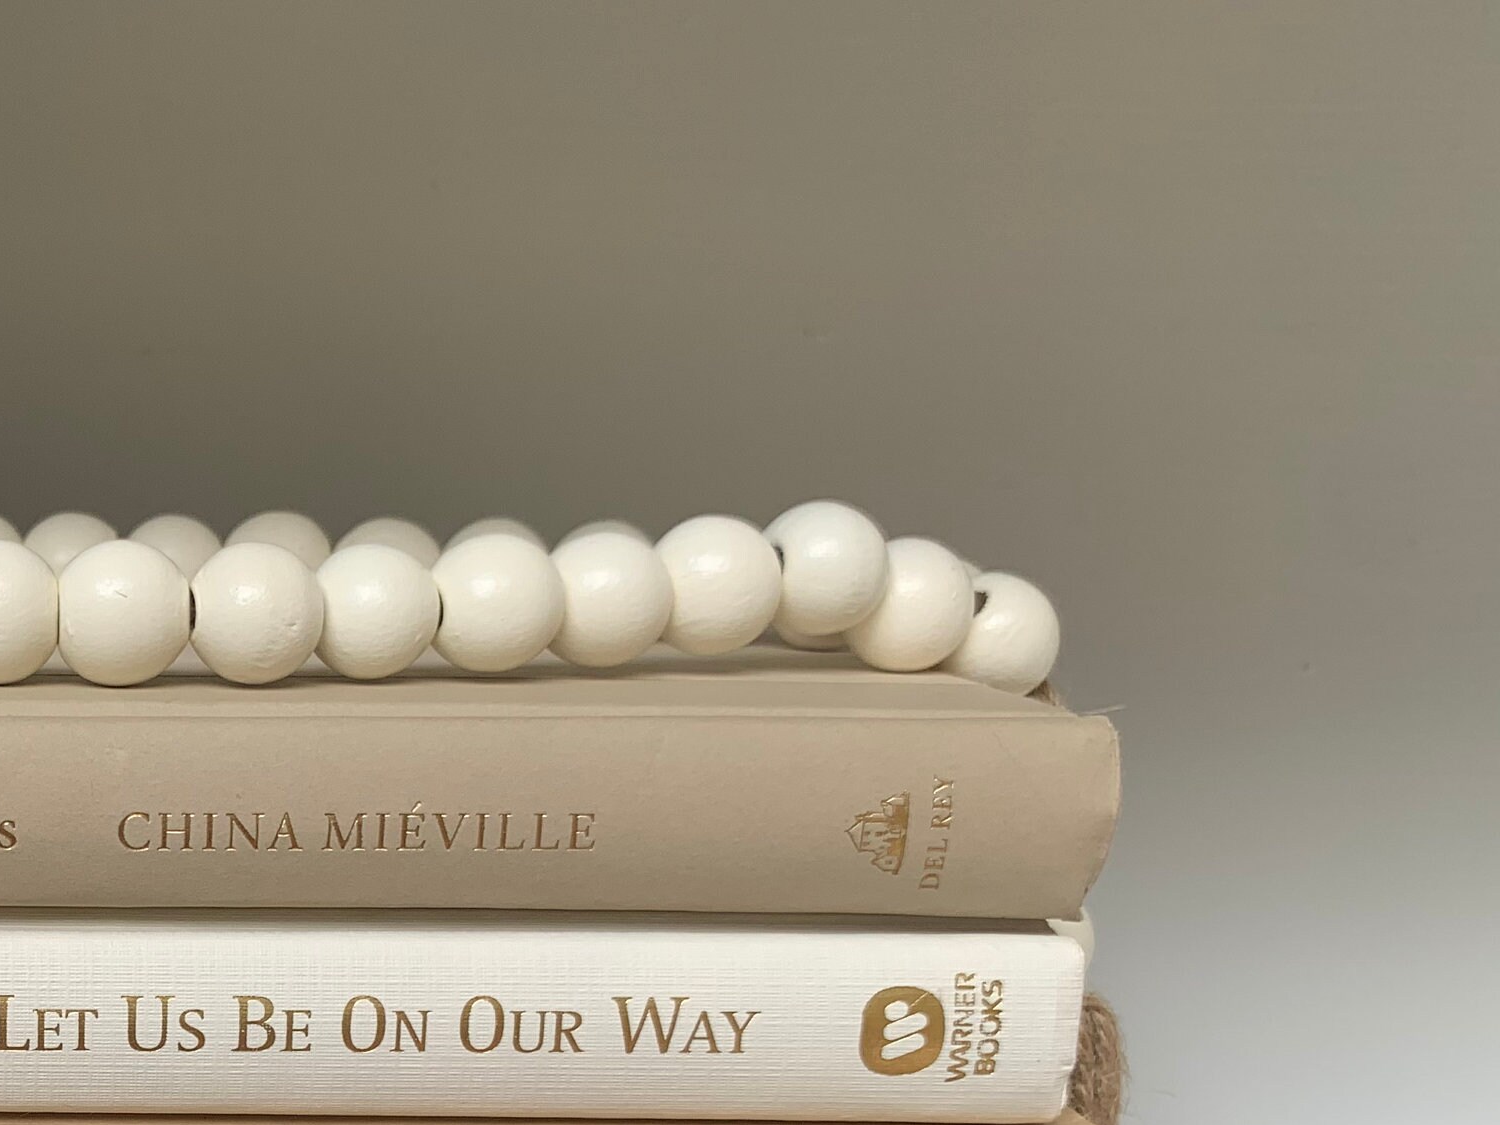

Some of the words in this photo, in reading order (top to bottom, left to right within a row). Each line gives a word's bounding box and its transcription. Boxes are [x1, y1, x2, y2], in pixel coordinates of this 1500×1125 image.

[117, 811, 303, 853] CHINA
[321, 801, 598, 853] MIÉVILLE
[930, 775, 955, 830] REY
[918, 838, 948, 890] DEL
[120, 995, 207, 1053] US
[231, 995, 313, 1053] BE
[341, 995, 433, 1054] ON
[458, 995, 584, 1054] OUR
[611, 996, 762, 1054] WAY
[944, 971, 977, 1083] WARNER
[973, 978, 1003, 1076] BOOKS
